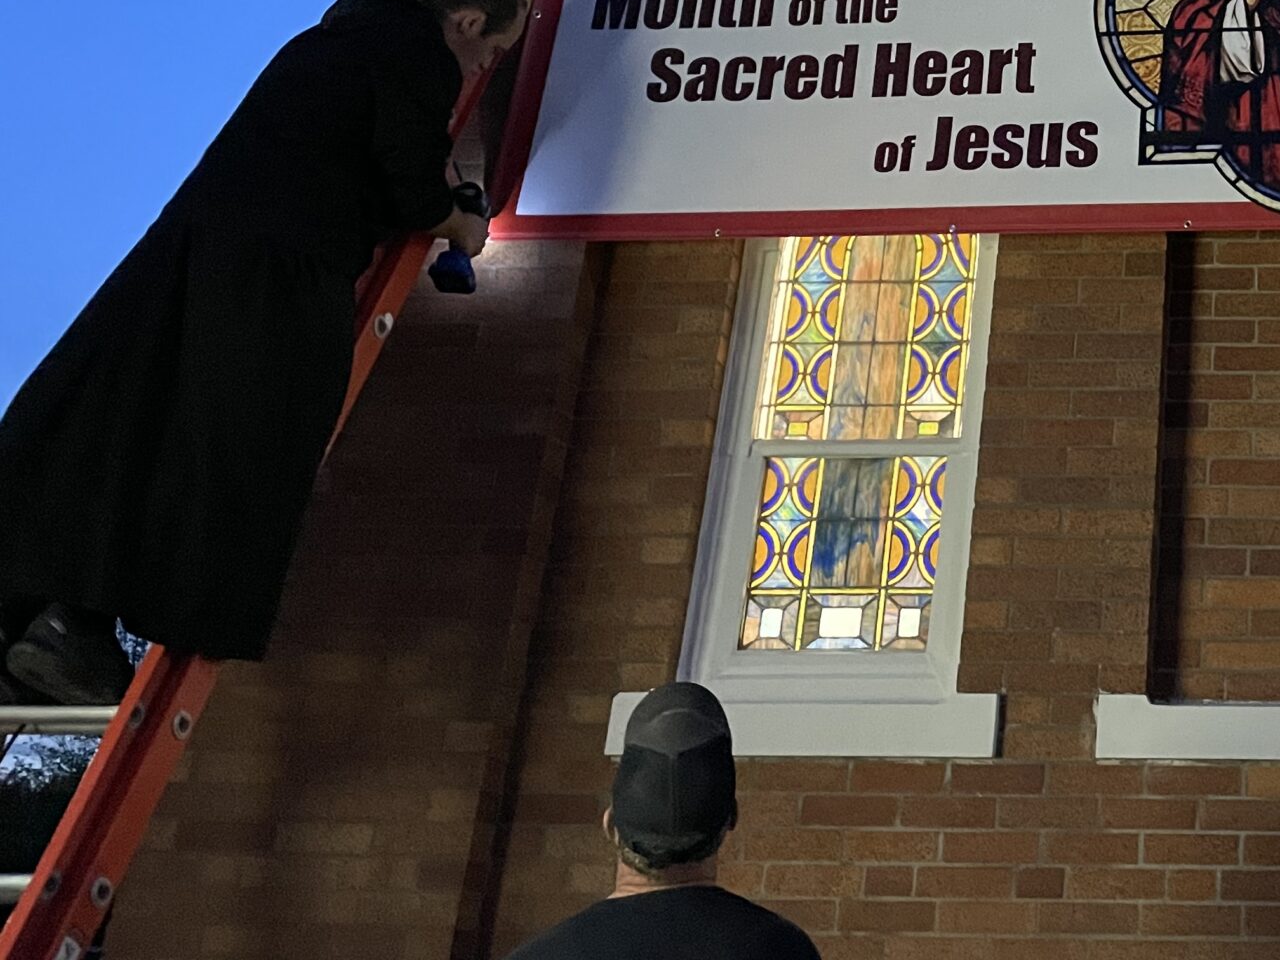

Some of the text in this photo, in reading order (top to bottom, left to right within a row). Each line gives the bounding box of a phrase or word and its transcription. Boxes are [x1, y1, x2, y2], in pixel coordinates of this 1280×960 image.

[646, 42, 1036, 104] Sacred Heart
[874, 116, 1099, 173] of Jesus
